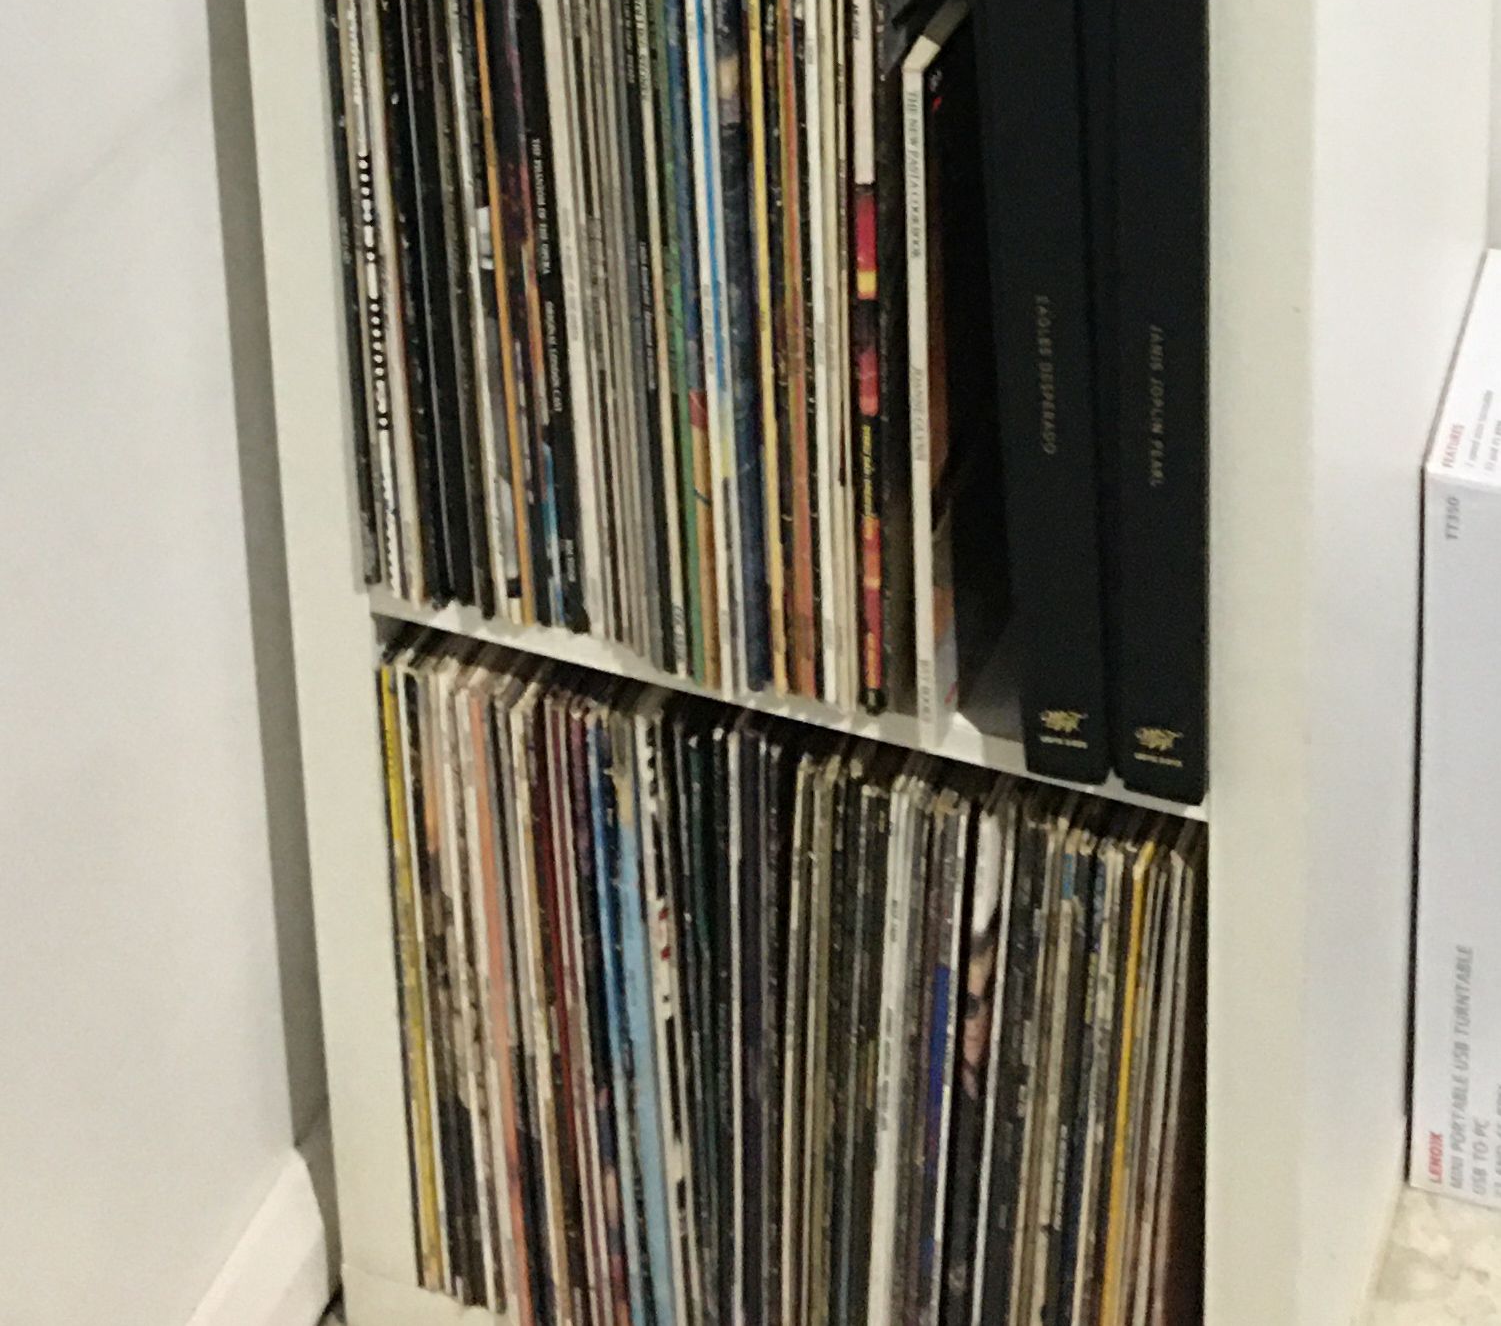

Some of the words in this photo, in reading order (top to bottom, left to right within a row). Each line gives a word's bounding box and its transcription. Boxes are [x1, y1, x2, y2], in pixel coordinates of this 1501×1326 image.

[907, 92, 918, 114] THE
[908, 118, 919, 147] NEW
[534, 159, 546, 205] PHANTOM
[908, 150, 920, 188] PASTA
[1149, 325, 1164, 371] JANIS
[1038, 362, 1057, 455] DESPERADO
[1149, 377, 1165, 434] JOPLIN
[1150, 439, 1164, 487] PEARL
[1442, 423, 1465, 468] FEATURES
[1454, 945, 1473, 1036] TURNTABLE
[1453, 1041, 1470, 1071] USB
[1450, 1075, 1469, 1153] PORTABLE
[1473, 1119, 1488, 1138] PC
[1472, 1141, 1486, 1162] TO
[1472, 1167, 1487, 1195] USB
